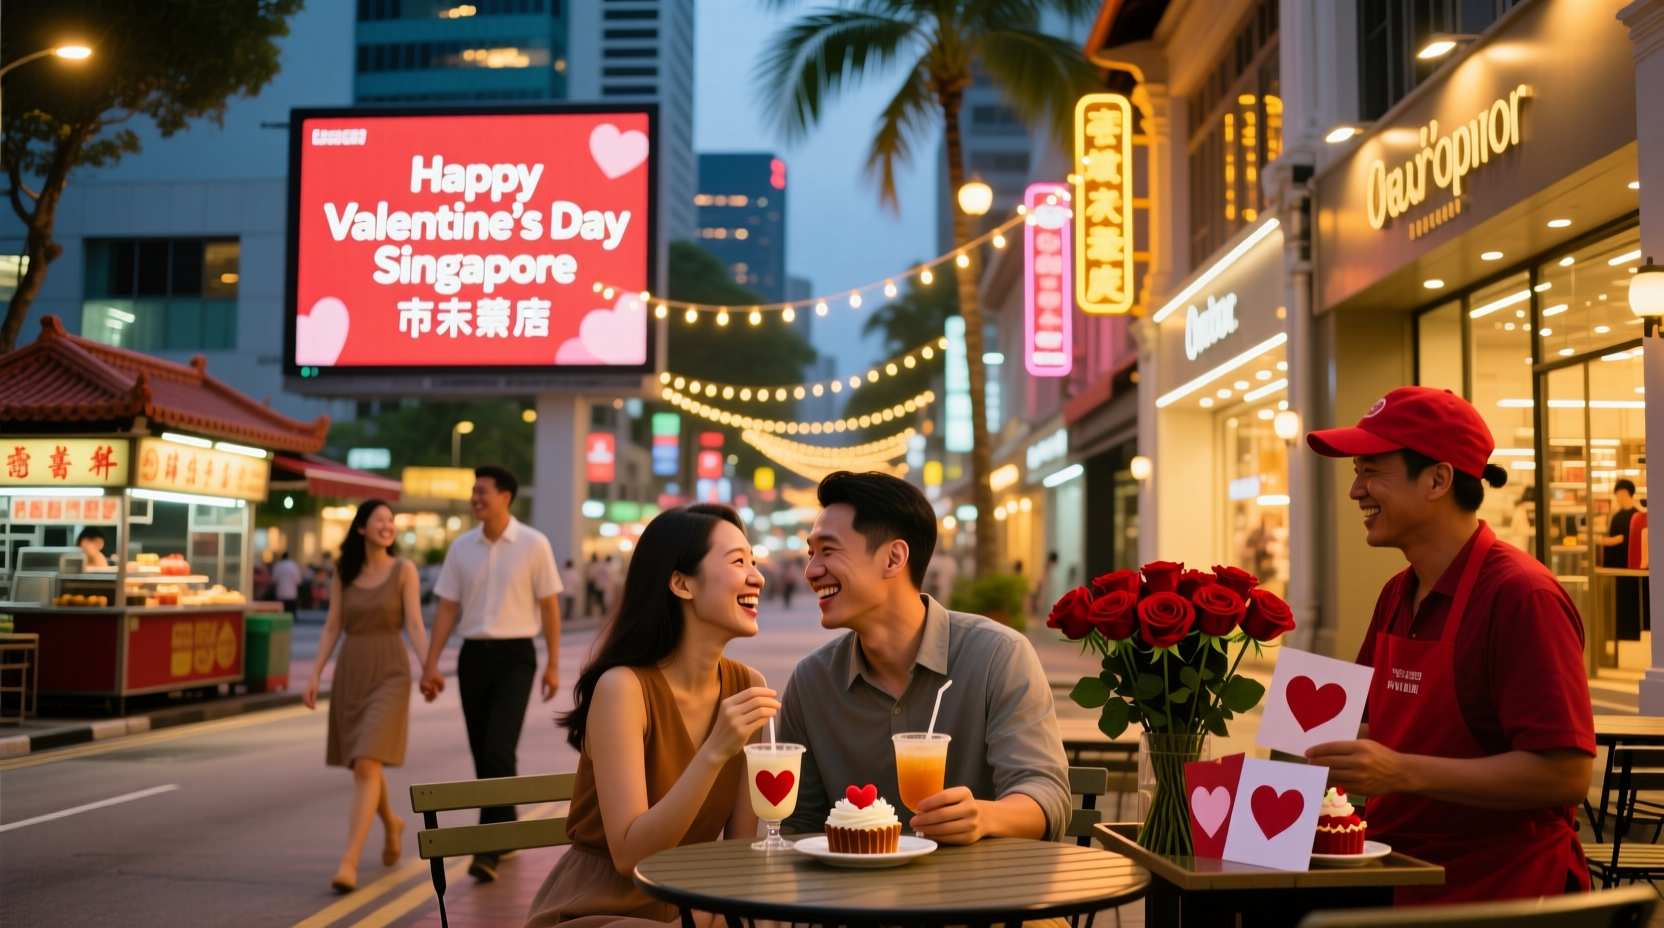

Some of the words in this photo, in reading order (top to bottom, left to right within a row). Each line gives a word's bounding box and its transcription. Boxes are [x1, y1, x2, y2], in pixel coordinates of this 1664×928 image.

[410, 155, 545, 203] Happy
[323, 200, 544, 241] Valentine's
[550, 200, 632, 251] Day
[373, 244, 578, 295] Singapore
